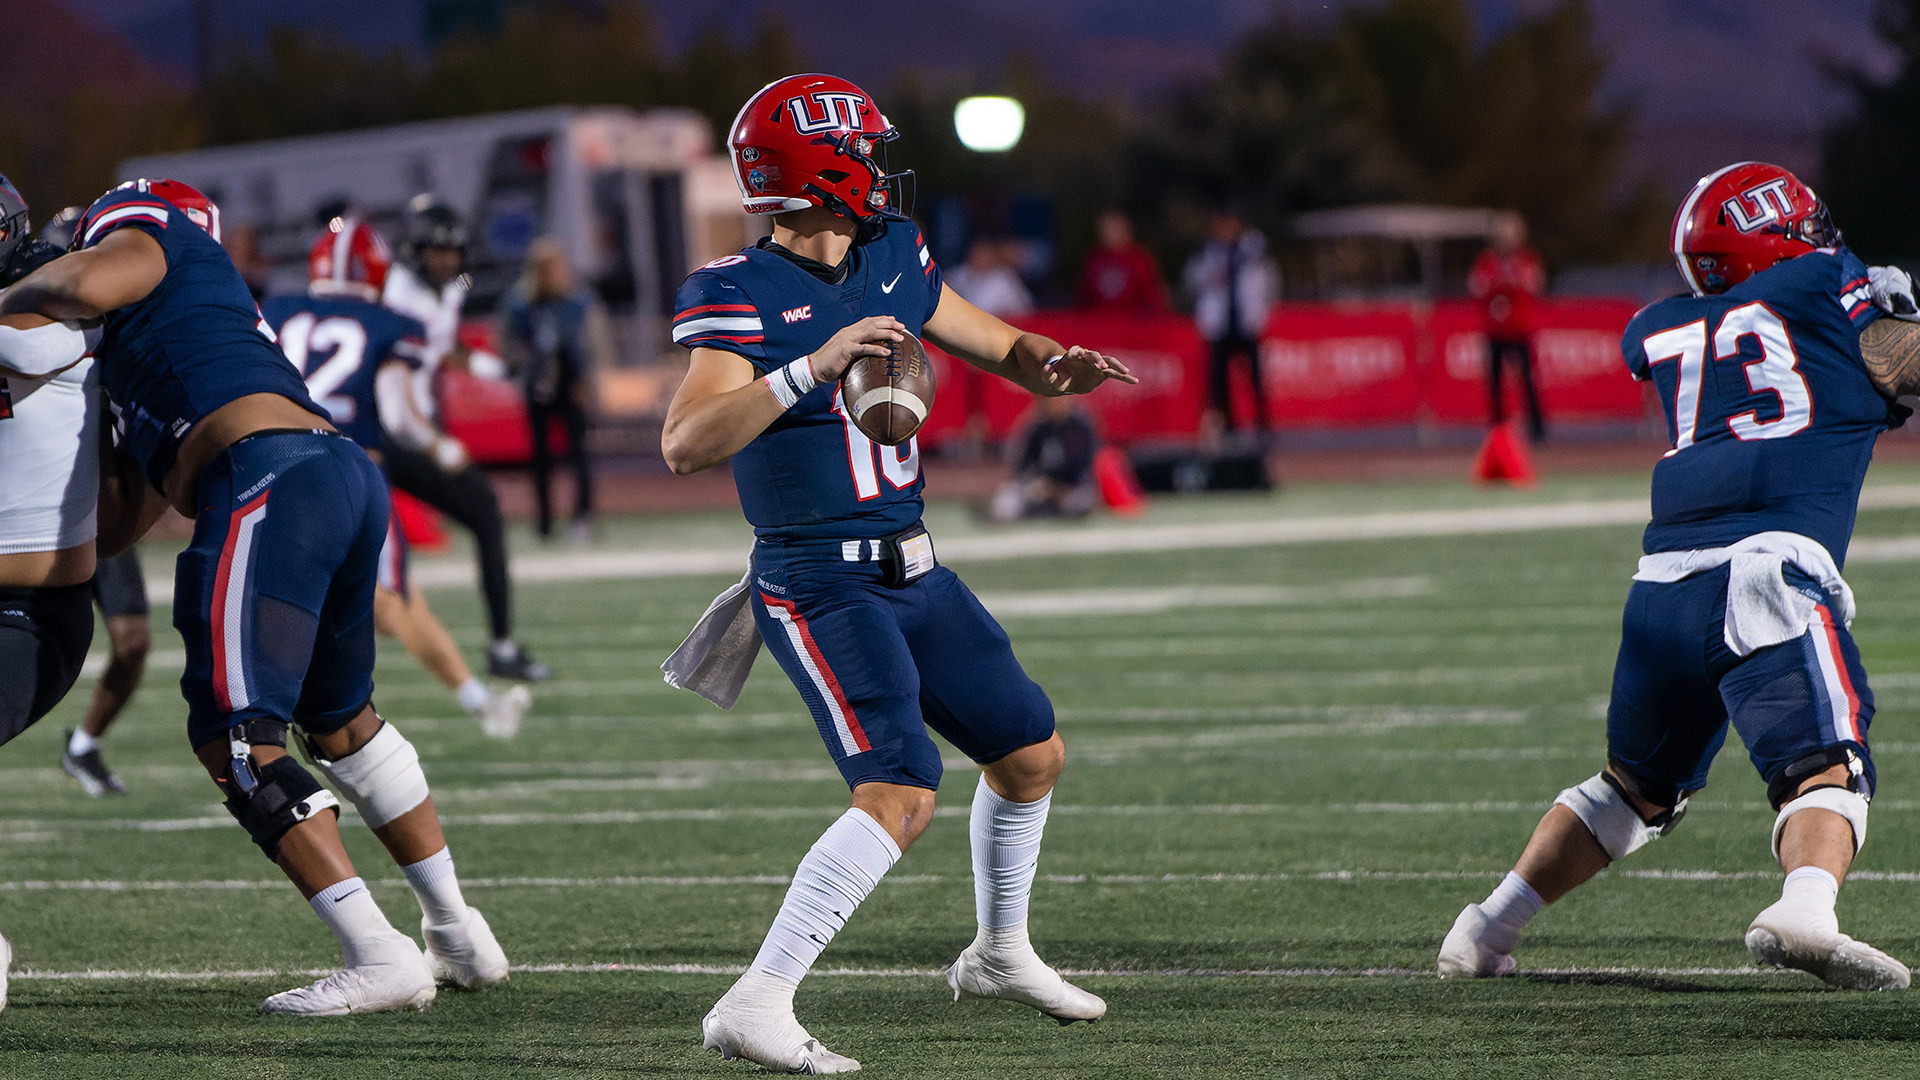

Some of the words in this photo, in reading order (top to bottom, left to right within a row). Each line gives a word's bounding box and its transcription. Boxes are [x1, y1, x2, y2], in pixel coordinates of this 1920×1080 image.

[278, 311, 367, 423] 12
[781, 305, 812, 324] WAC
[1642, 300, 1814, 457] 73
